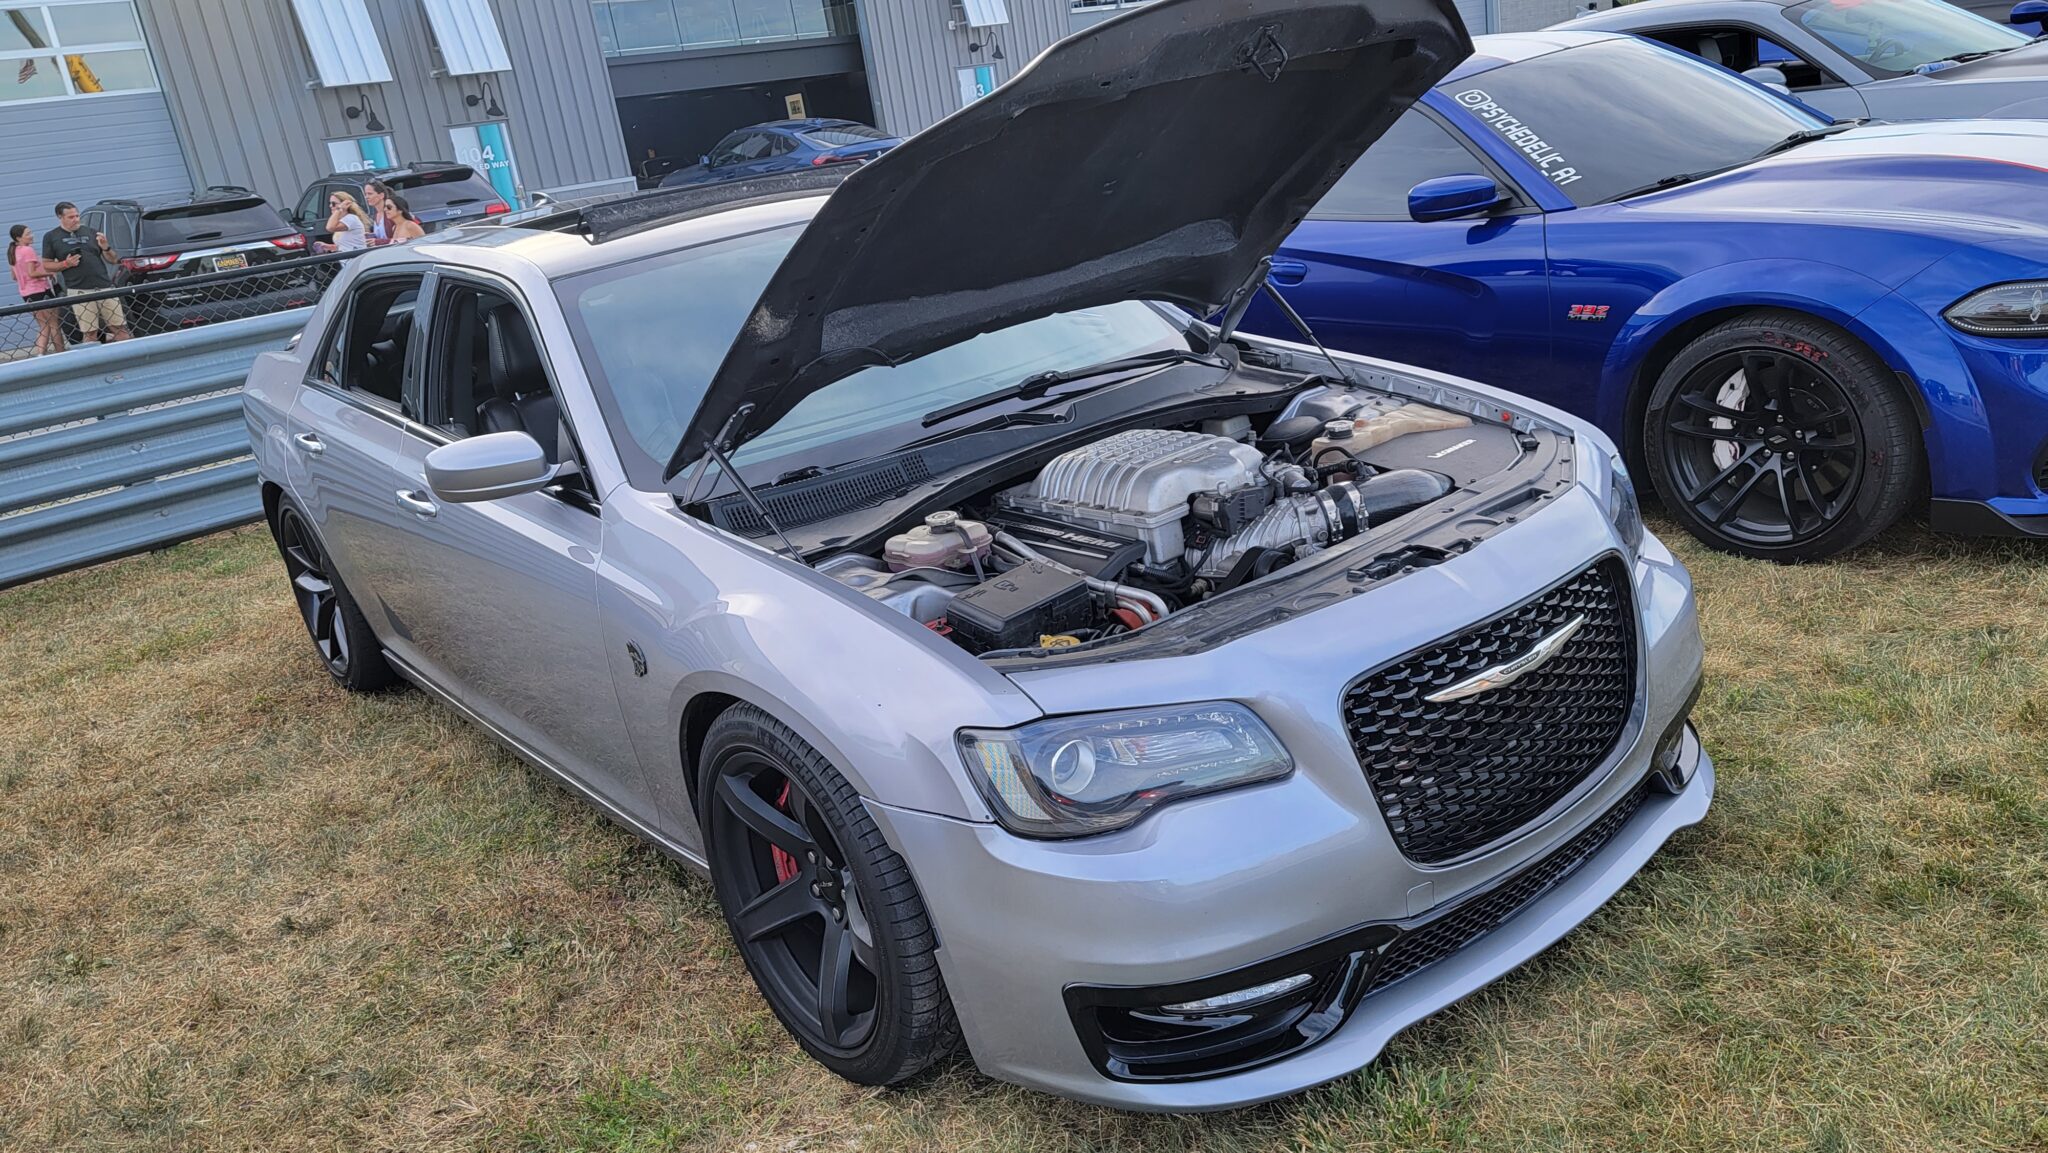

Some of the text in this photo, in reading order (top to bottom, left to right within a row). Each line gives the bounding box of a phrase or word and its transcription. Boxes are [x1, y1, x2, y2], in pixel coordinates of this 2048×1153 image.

[1472, 101, 1582, 185] PSYCHEDELIC_A1
[461, 145, 495, 163] 104
[491, 160, 509, 169] WAY
[1569, 304, 1610, 316] 392
[1062, 532, 1123, 549] HEMI
[773, 740, 847, 829] MICHELIN
